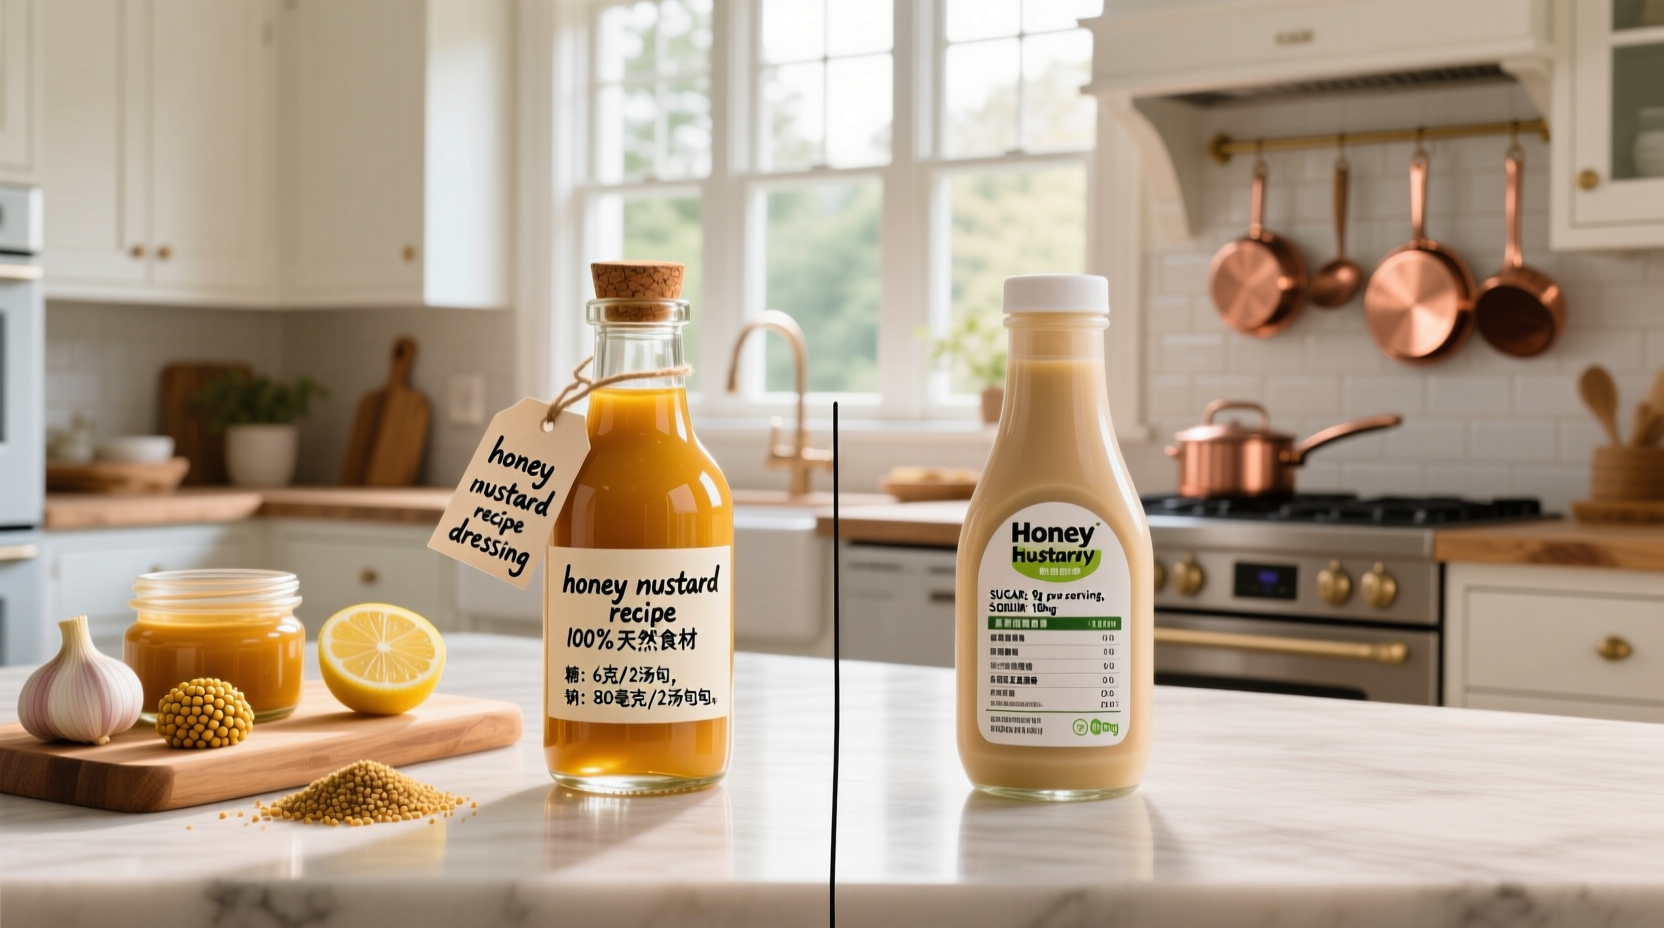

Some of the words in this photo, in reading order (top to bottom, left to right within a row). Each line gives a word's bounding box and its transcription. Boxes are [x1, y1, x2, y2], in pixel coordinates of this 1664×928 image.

[487, 435, 555, 490] honey
[473, 506, 524, 536] recipe
[1011, 521, 1095, 548] Honey
[448, 517, 530, 578] dressing
[562, 563, 628, 605] honey
[609, 601, 677, 628] recipe
